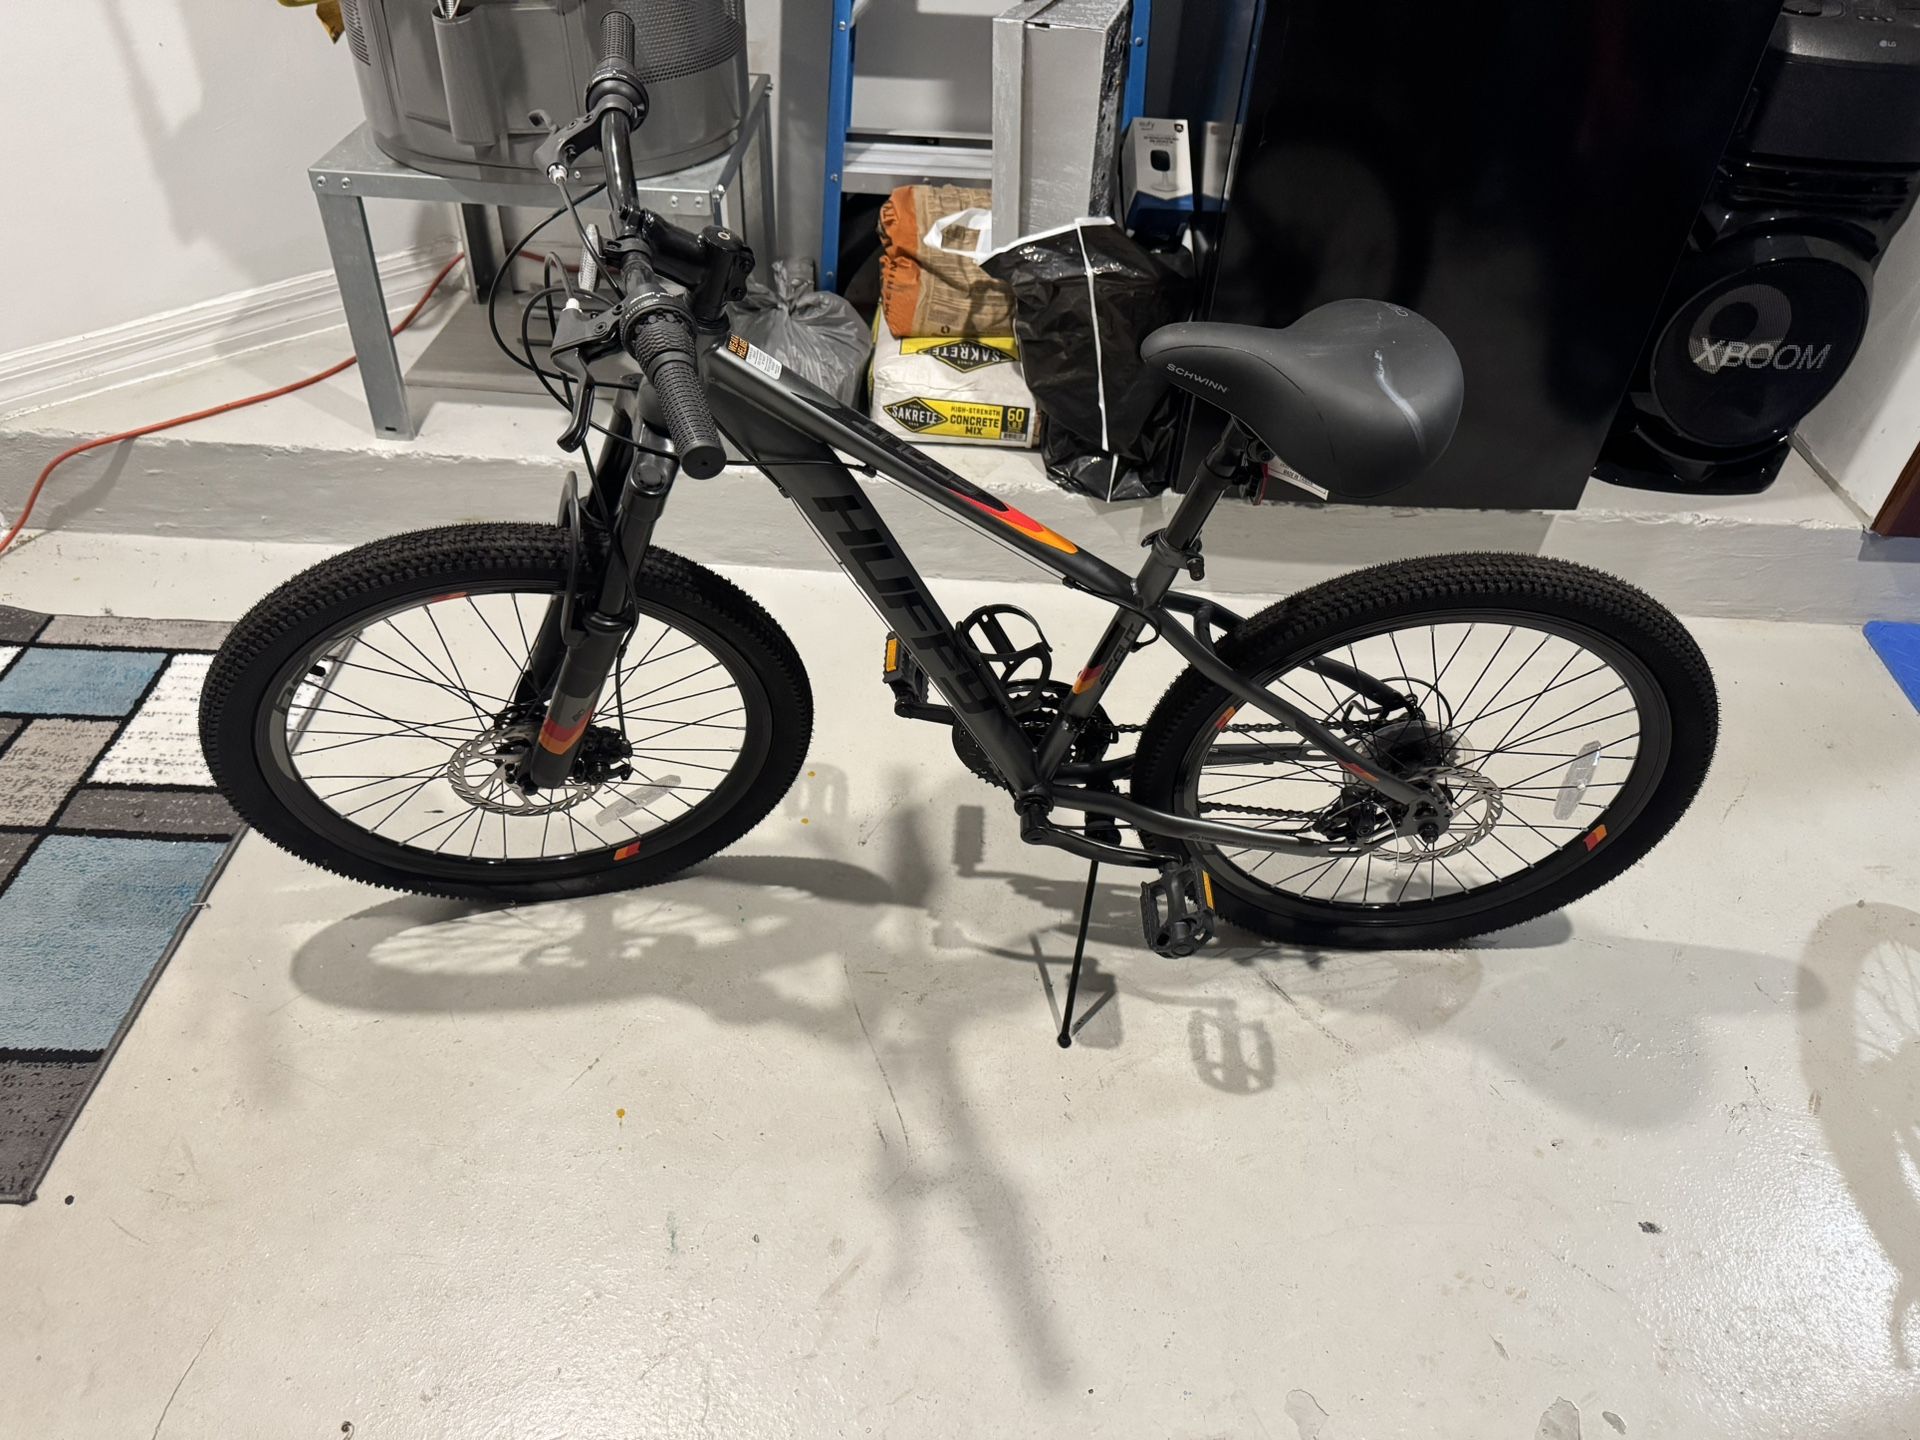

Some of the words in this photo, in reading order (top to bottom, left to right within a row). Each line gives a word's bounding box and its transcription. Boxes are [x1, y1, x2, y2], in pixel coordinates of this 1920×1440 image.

[932, 347, 1001, 363] SAKRETE
[1692, 337, 1833, 370] XBOOM
[1166, 363, 1228, 393] SCHWINN
[891, 404, 938, 424] SAKRETE
[951, 406, 1001, 417] HIGH-STRENGTH
[1007, 408, 1025, 422] 60
[950, 414, 1000, 429] CONCRETE
[965, 426, 983, 435] MIX
[812, 494, 997, 715] HUFFY
